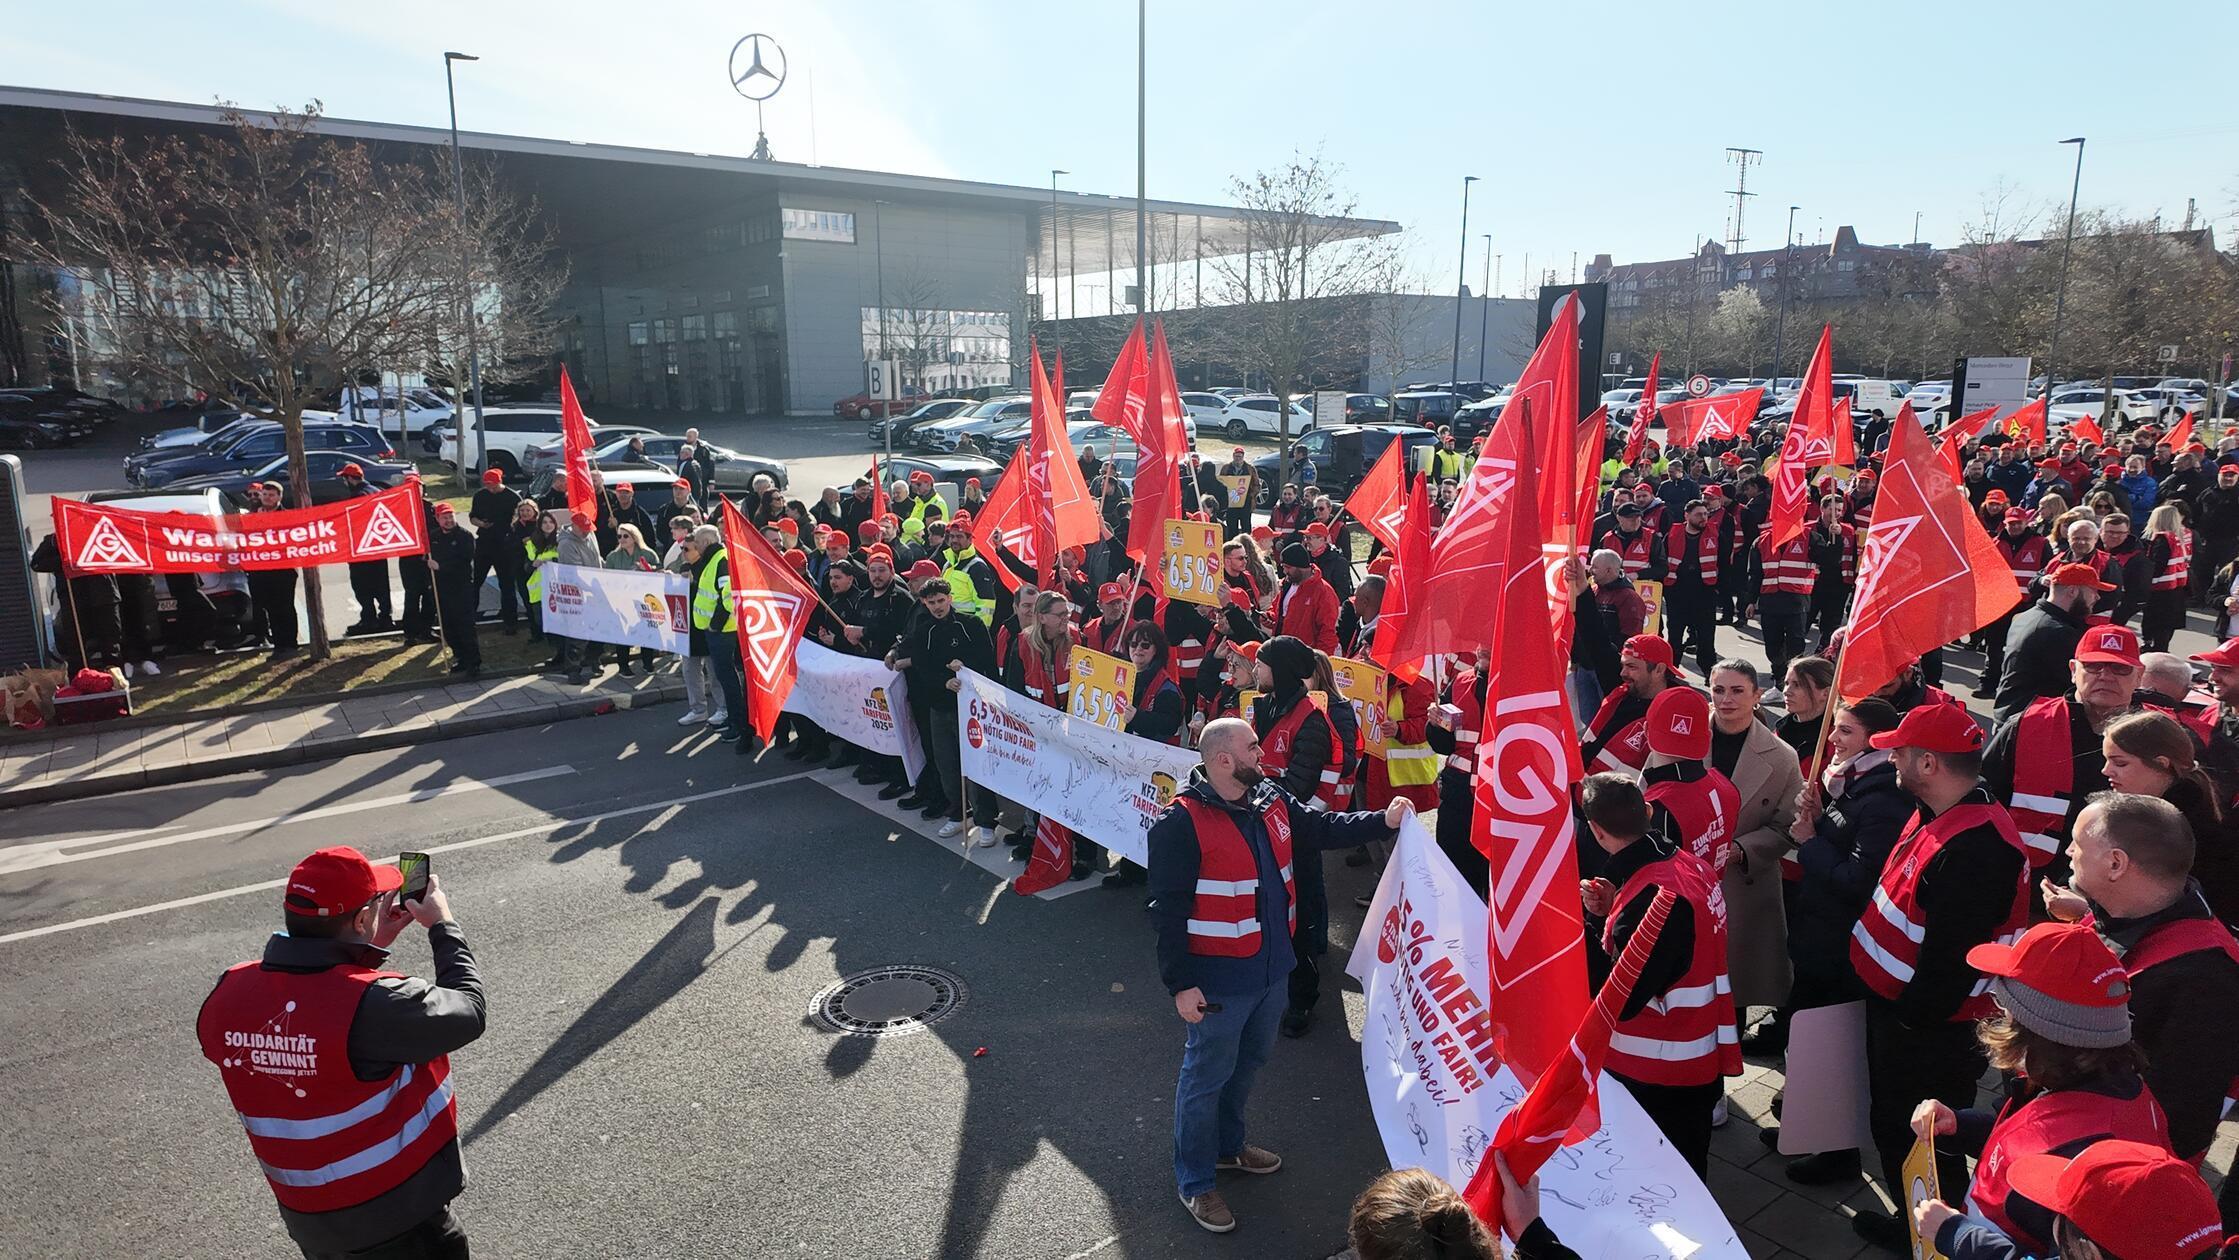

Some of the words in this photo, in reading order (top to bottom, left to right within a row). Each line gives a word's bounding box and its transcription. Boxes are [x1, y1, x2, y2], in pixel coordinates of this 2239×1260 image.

[871, 367, 881, 394] B
[1695, 380, 1703, 391] 5
[162, 520, 337, 547] Warnstreik
[165, 550, 222, 563] unser
[227, 551, 281, 565] gutes
[286, 539, 337, 559] Recht
[871, 719, 888, 731] 2025
[983, 723, 1003, 740] NÖTIG
[1004, 731, 1018, 745] UND
[1019, 737, 1036, 752] FAIR!
[1141, 782, 1156, 801] KFZ
[225, 1031, 316, 1053] SOLIDARITÄT
[1411, 988, 1440, 1033] UND
[1431, 1031, 1484, 1094] FAIR!
[251, 1049, 317, 1069] GEWINNT
[1411, 1039, 1461, 1107] dabei!
